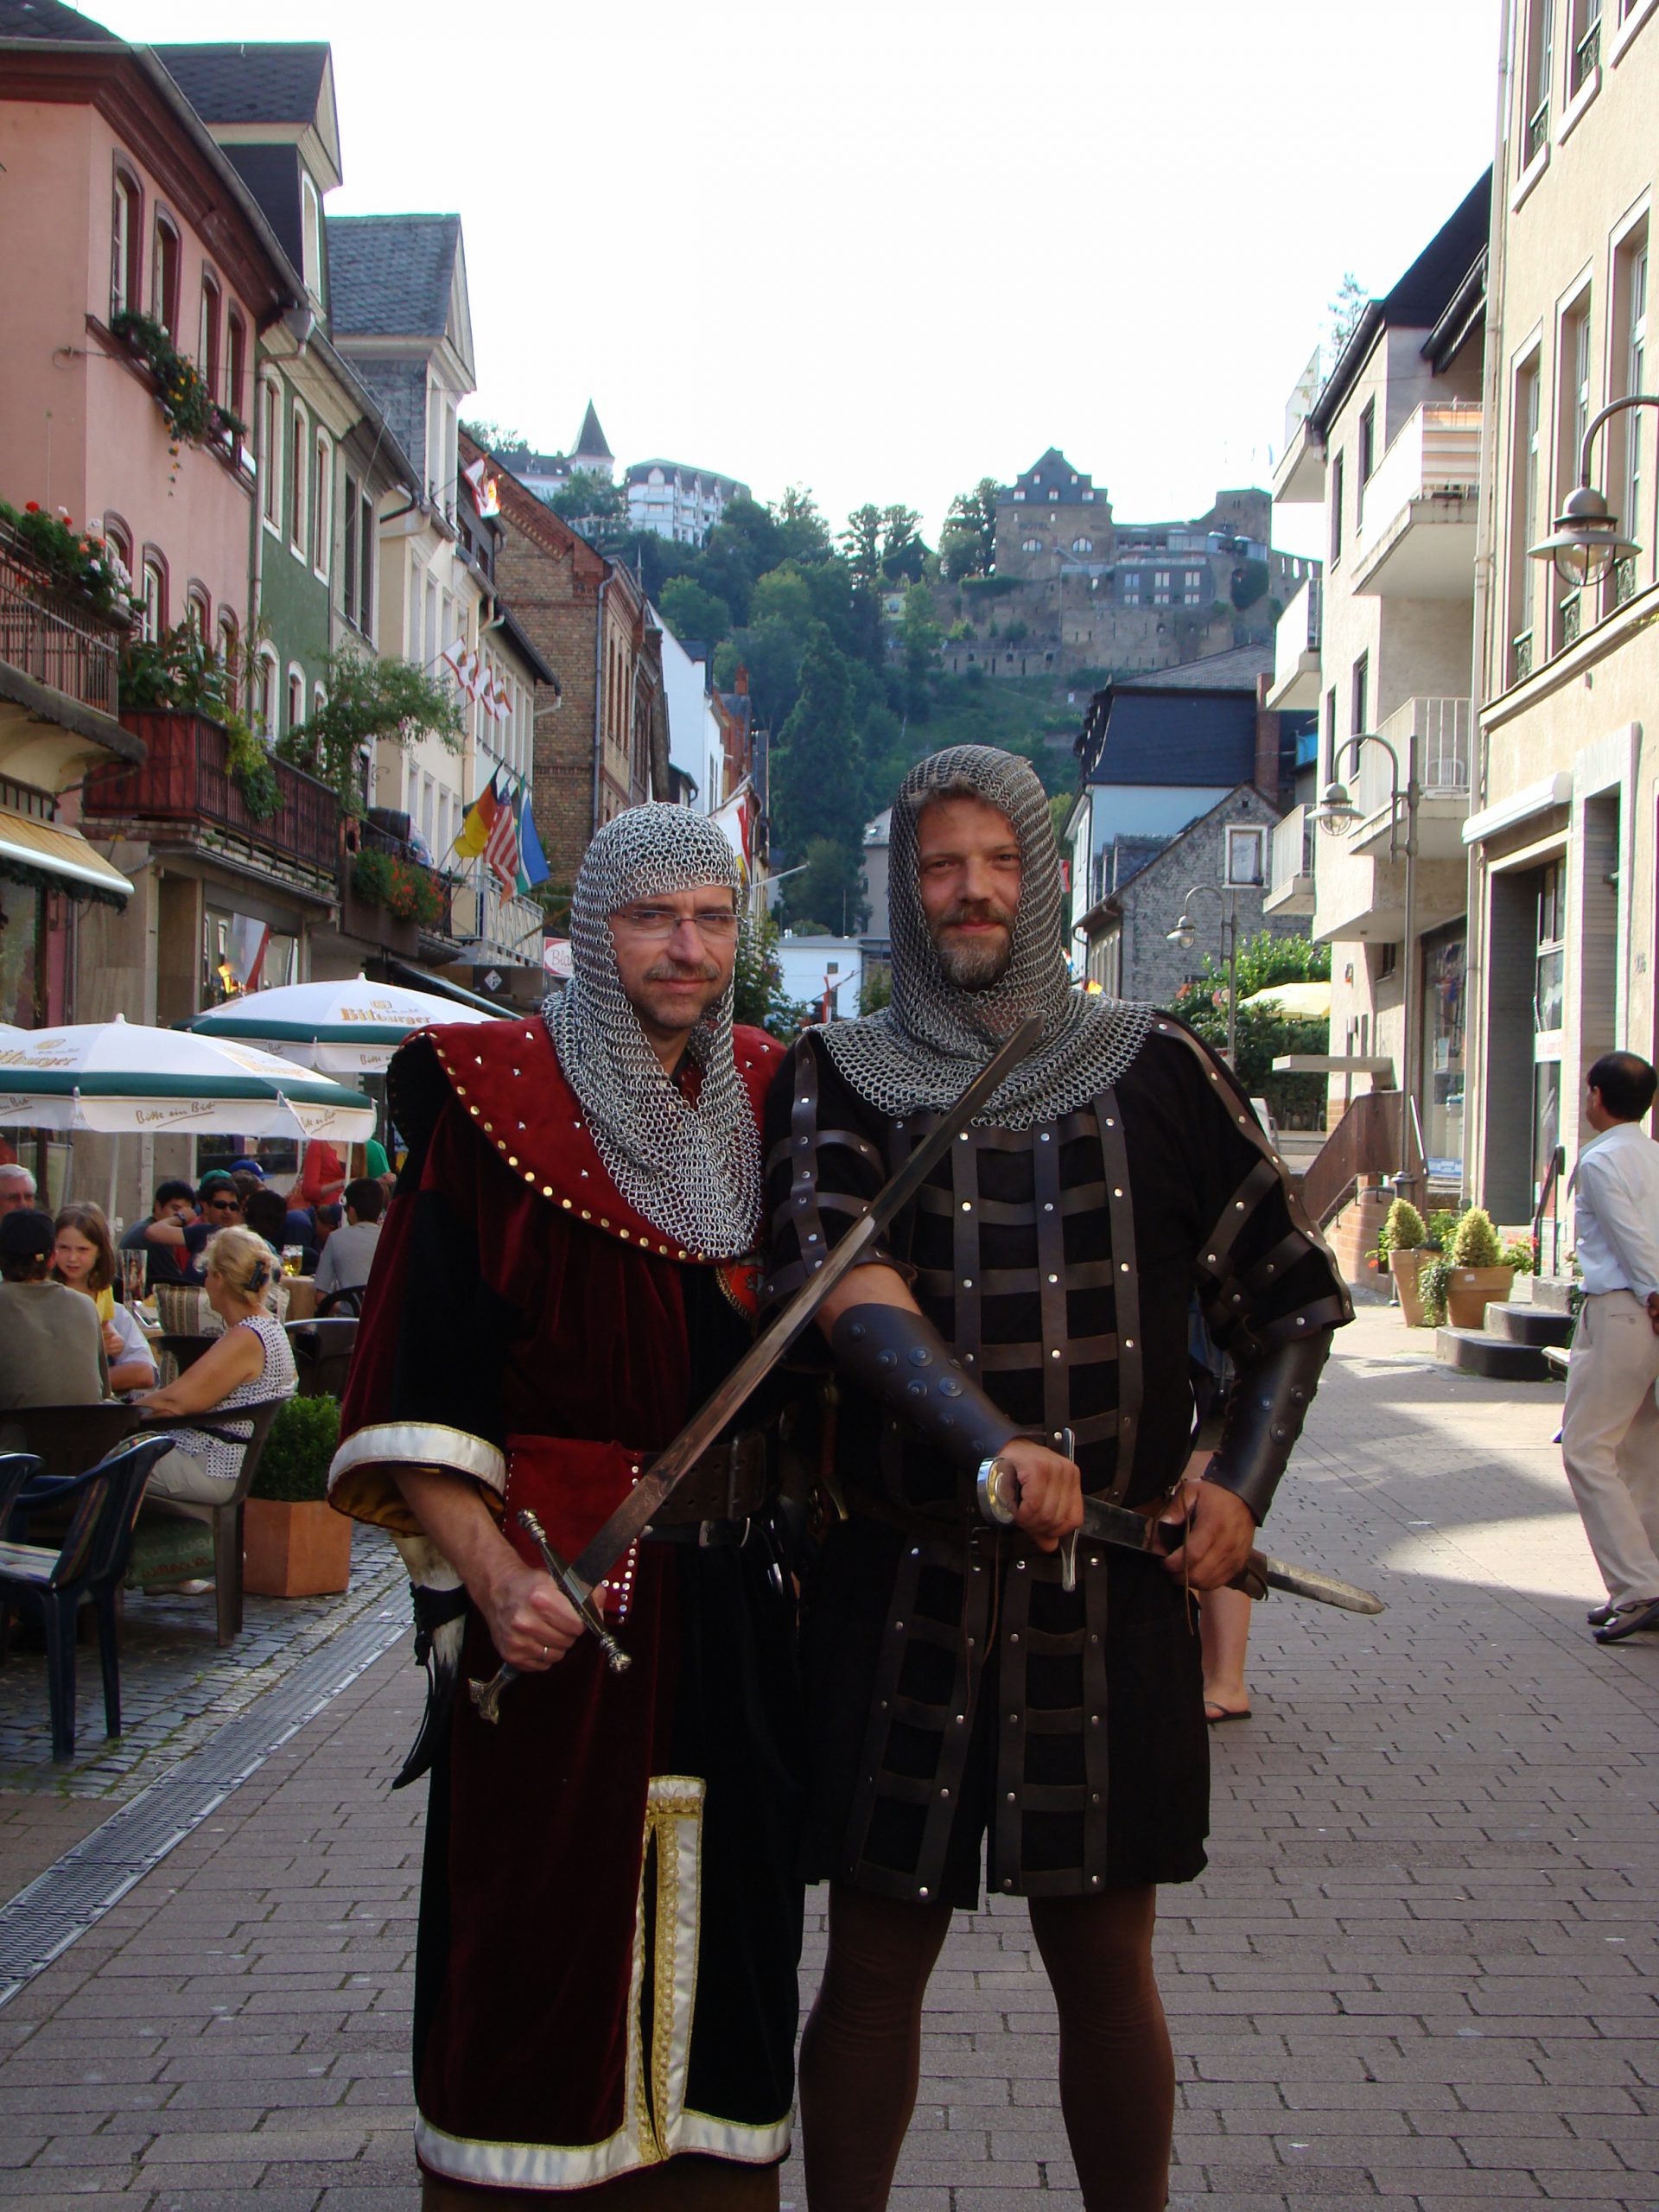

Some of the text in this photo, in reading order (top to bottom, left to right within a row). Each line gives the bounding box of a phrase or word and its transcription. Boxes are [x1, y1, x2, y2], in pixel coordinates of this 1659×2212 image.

[552, 949, 571, 967] Bla
[340, 1007, 430, 1025] Bitburger
[191, 1101, 215, 1113] Bit
